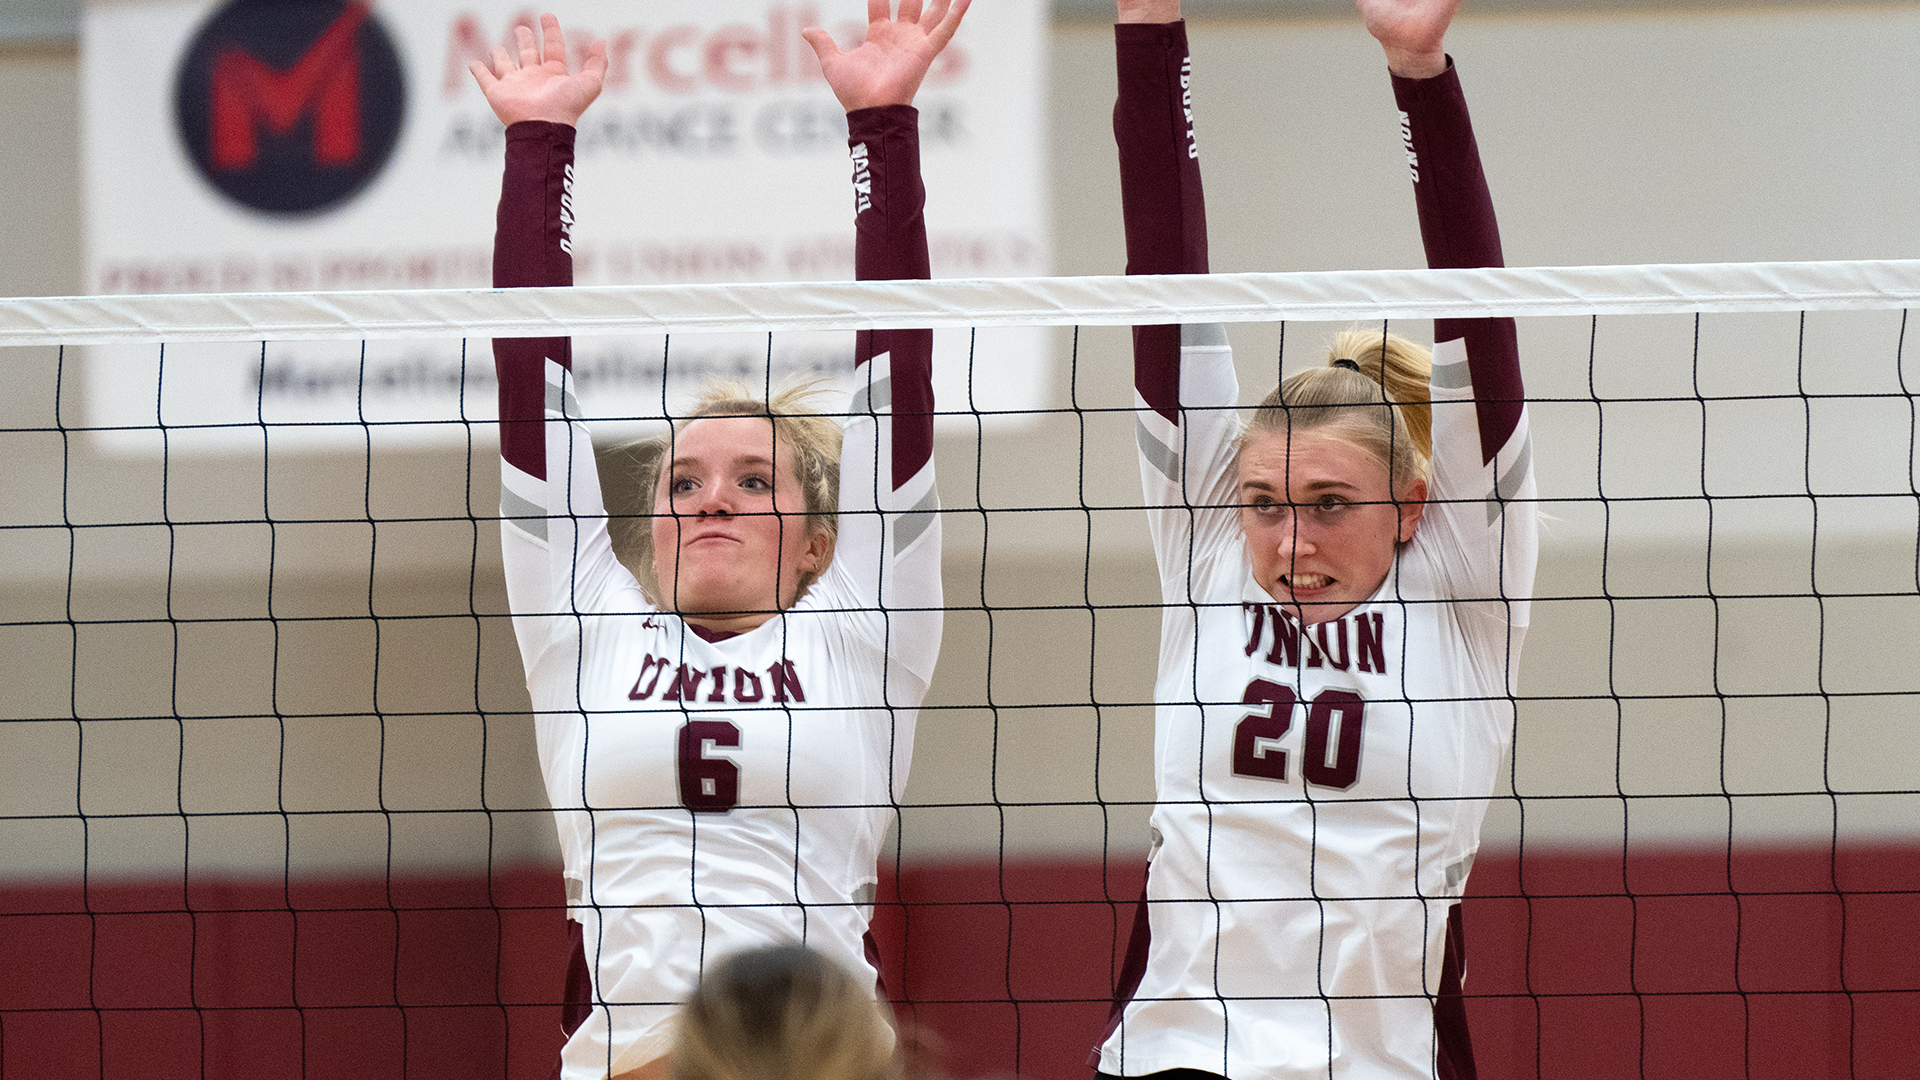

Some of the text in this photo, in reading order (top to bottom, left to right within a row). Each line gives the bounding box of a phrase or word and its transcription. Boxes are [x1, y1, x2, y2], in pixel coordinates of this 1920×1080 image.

[628, 652, 807, 704] UNION
[674, 717, 744, 815] 6
[1230, 674, 1367, 792] 20
